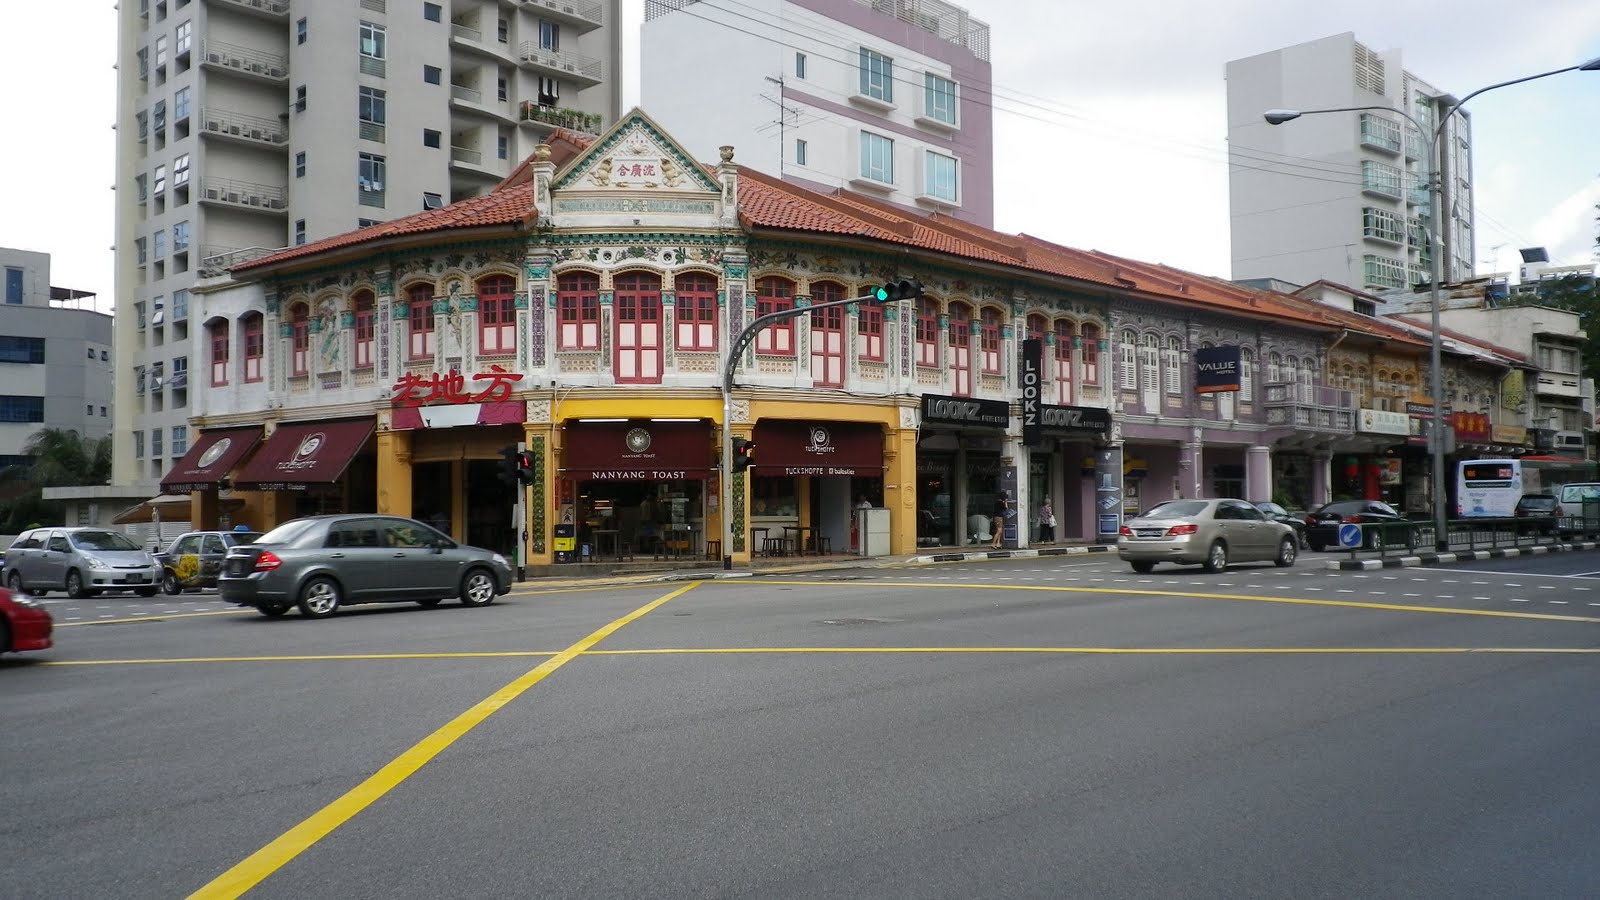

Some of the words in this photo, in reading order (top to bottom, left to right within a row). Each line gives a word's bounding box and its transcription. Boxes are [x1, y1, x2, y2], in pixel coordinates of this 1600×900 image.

[1198, 361, 1236, 371] VALUE
[391, 364, 524, 407] 老地方
[1024, 360, 1037, 426] LOOKZ
[928, 399, 981, 421] LOOKZ
[1041, 408, 1083, 427] LOOKZ
[592, 471, 645, 479] NANYANG
[652, 471, 685, 479] TOAST
